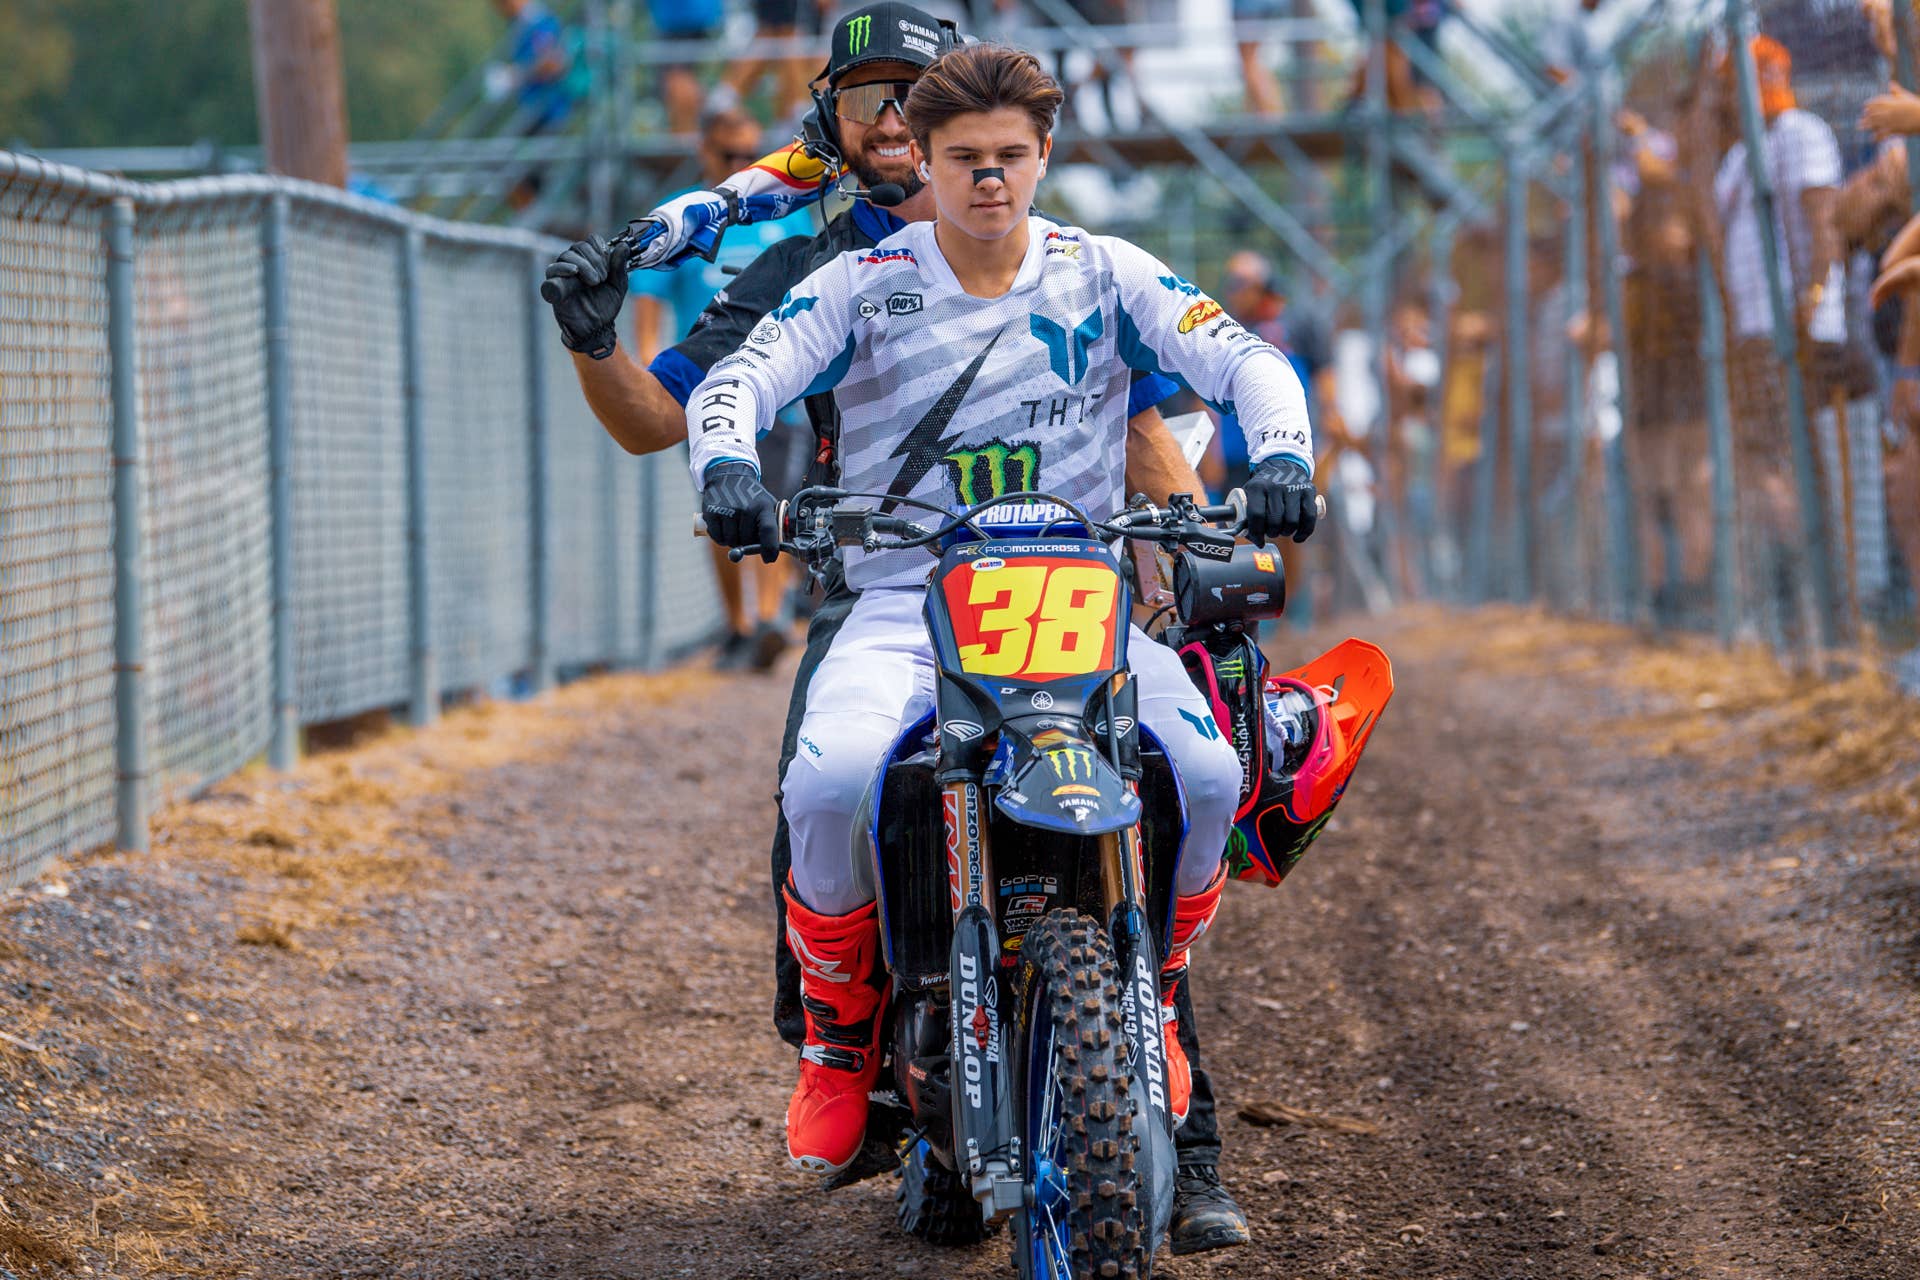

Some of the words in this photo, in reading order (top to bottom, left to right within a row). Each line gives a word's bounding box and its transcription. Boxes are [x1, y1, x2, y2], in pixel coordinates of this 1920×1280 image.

[909, 23, 940, 42] YAMAHA
[959, 566, 1118, 676] 38
[1236, 713, 1252, 792] MONSTER
[1058, 798, 1100, 811] YAMAHA
[1000, 875, 1057, 886] GoPro
[920, 975, 942, 986] Twin
[959, 953, 981, 1109] DUNLOP
[986, 1008, 999, 1062] CYCRA
[1136, 955, 1165, 1112] DUNLOP
